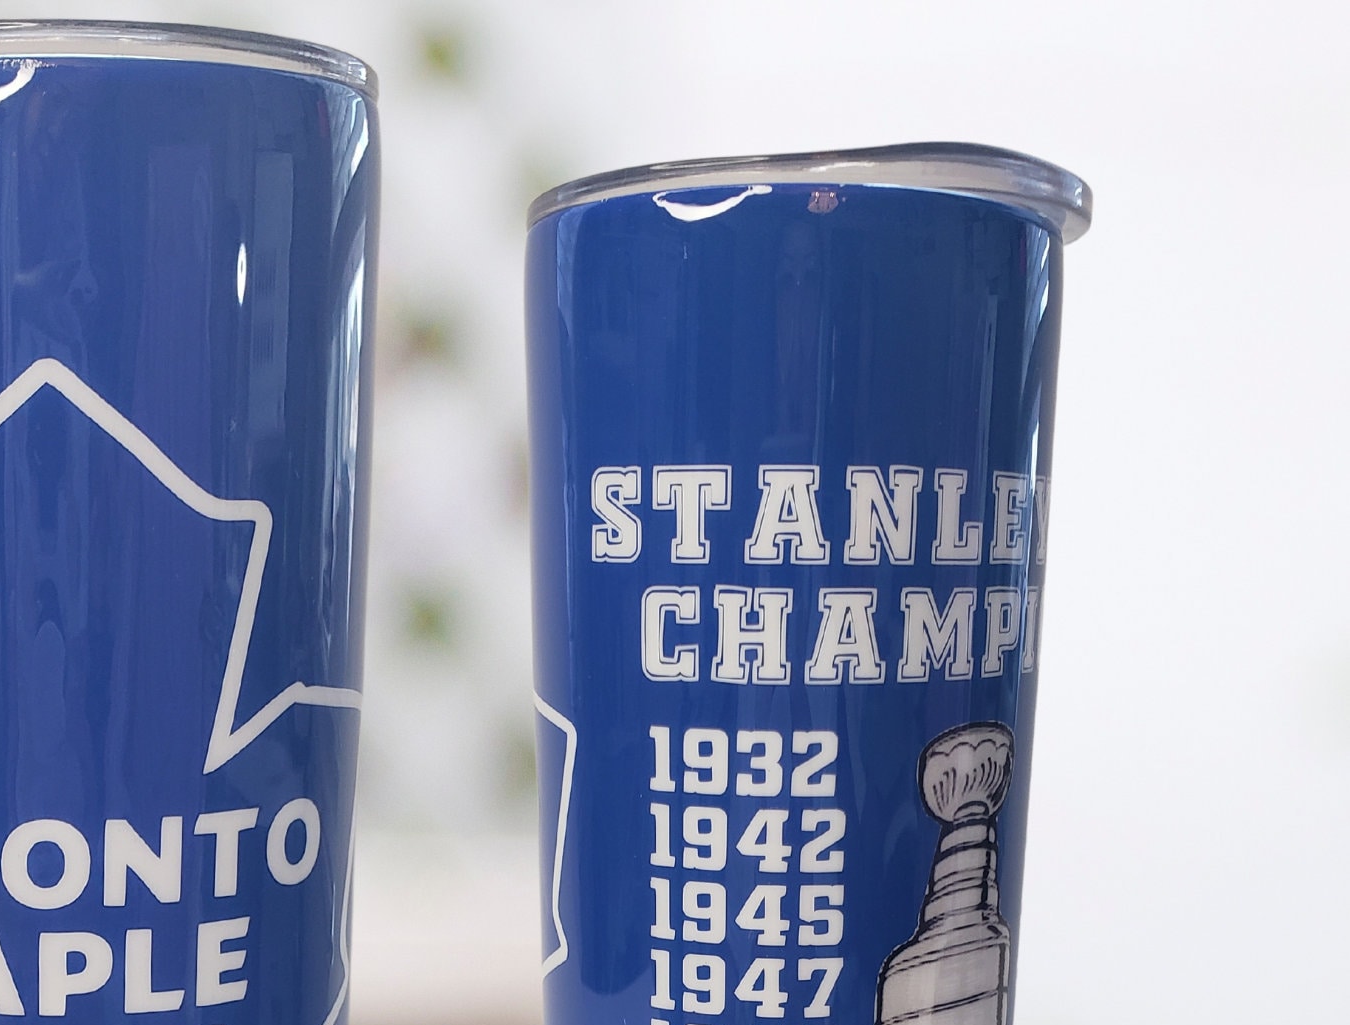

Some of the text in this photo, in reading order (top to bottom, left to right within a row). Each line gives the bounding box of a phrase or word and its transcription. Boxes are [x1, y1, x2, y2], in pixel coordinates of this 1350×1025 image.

[640, 585, 1040, 685] CHAMPI
[648, 725, 839, 798] 1932
[649, 802, 847, 874] 1942
[649, 877, 845, 947] 1945
[649, 948, 845, 1019] 1947
